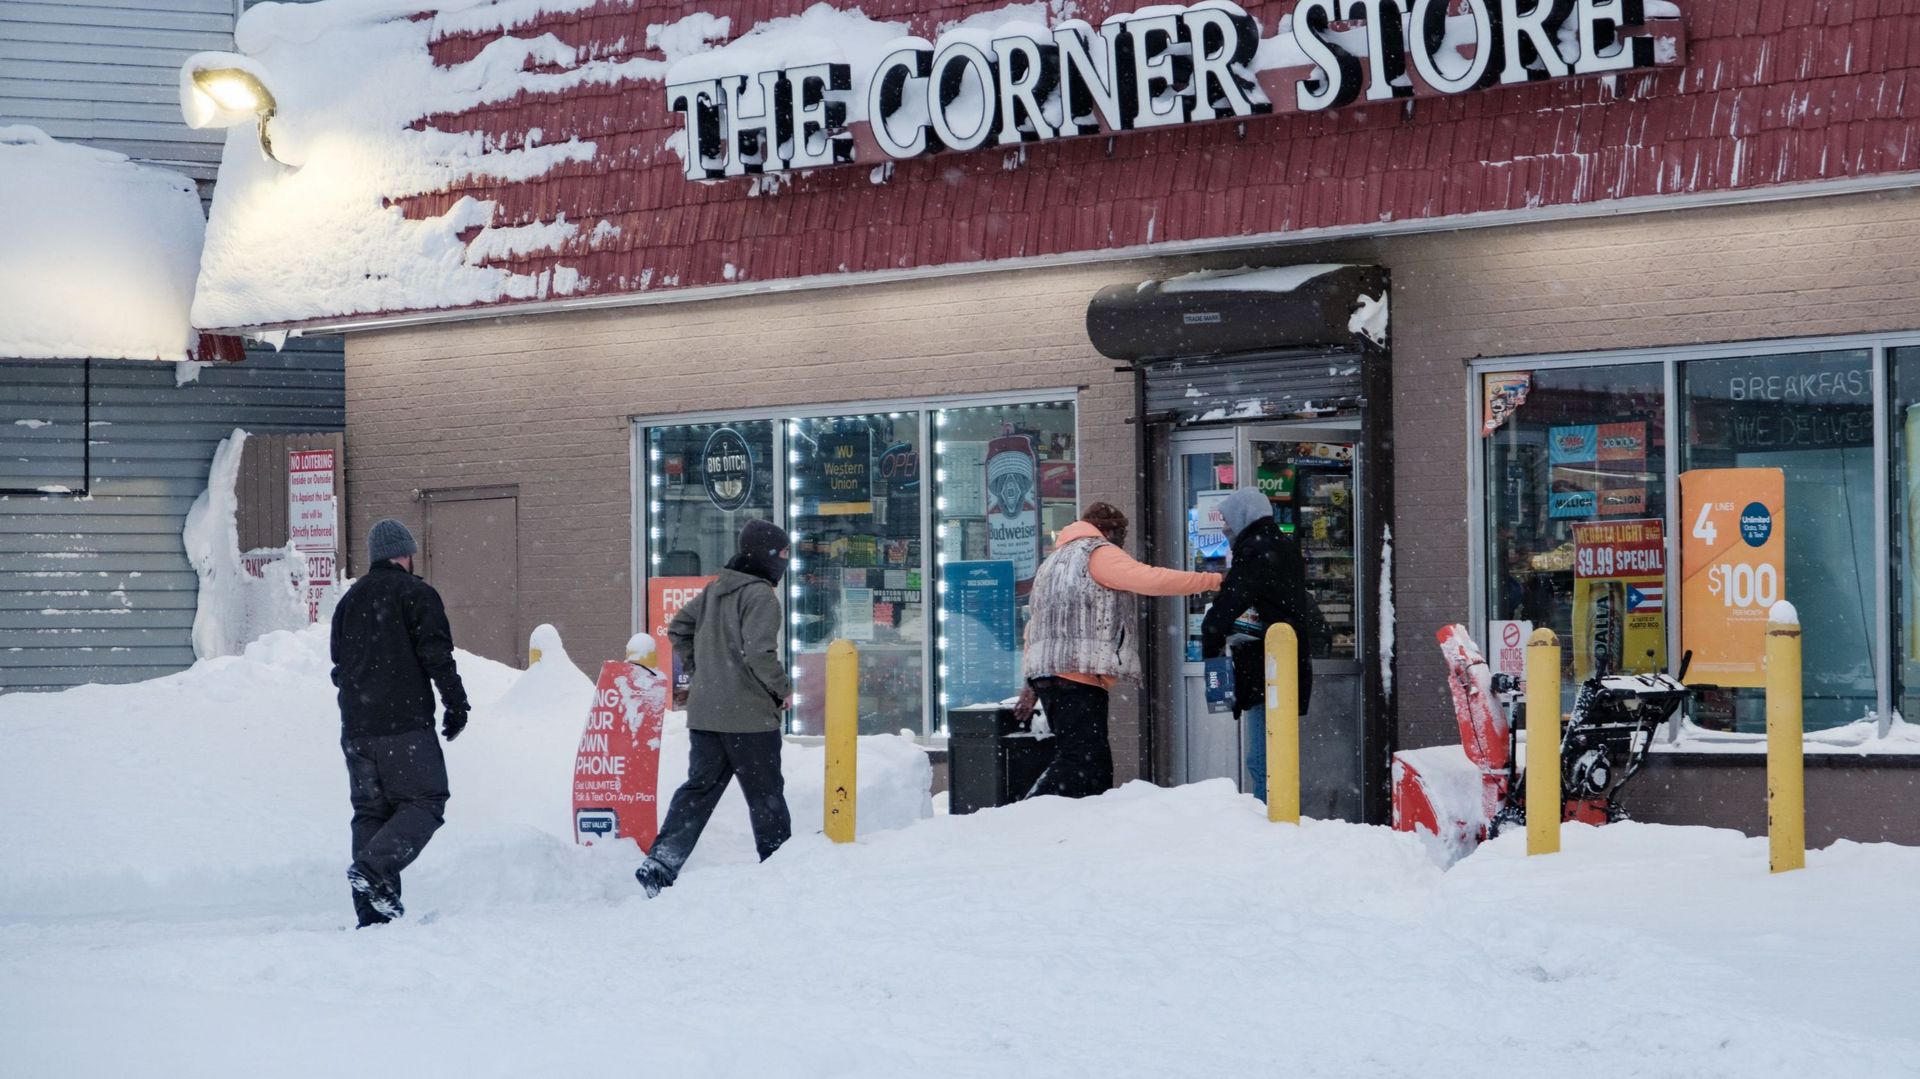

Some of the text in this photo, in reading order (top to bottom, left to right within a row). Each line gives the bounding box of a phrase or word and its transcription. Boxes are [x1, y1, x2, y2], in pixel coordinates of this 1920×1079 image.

[666, 0, 1635, 181] THE CORNER STORE
[1734, 415, 1776, 445] WE
[290, 453, 333, 470] NO LOITERING
[707, 454, 746, 473] BIG DITCH
[824, 462, 864, 475] Western
[291, 475, 306, 485] Inside
[313, 474, 331, 484] Outside
[831, 478, 858, 490] Union
[1257, 478, 1284, 491] port
[1692, 502, 1718, 546] 4
[1715, 502, 1735, 512] LINES
[1742, 515, 1770, 524] Unlimited
[292, 524, 332, 540] Strictly Enforced
[1615, 524, 1643, 543] LIGHT
[1578, 547, 1663, 576] $9.99 SPECIAL
[1707, 562, 1777, 608] $100
[1594, 596, 1609, 661] DALLA
[1500, 648, 1523, 660] NOTICE
[586, 711, 614, 730] OUR
[579, 733, 609, 753] OWN
[576, 755, 625, 775] PHONE
[585, 780, 622, 791] UNLIMITED
[605, 792, 617, 801] On
[618, 792, 634, 804] Any
[635, 792, 655, 801] Plan
